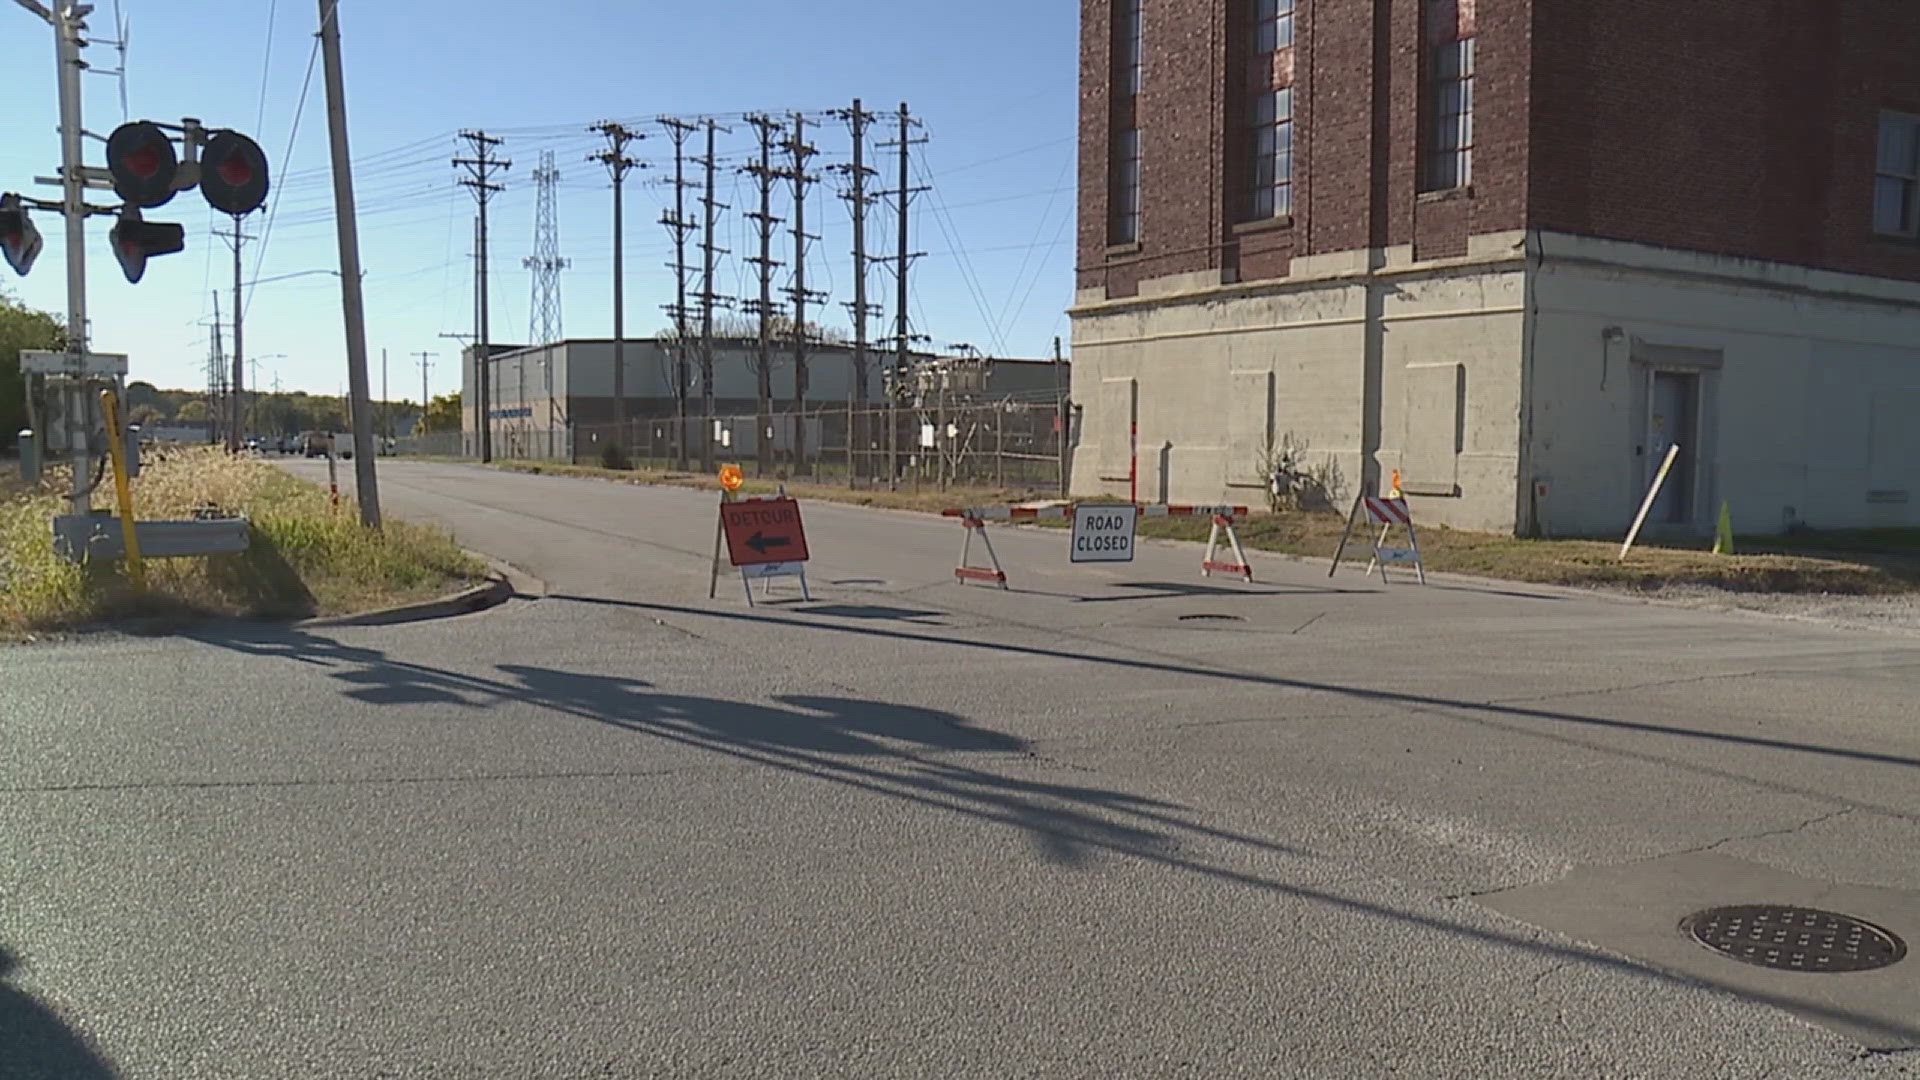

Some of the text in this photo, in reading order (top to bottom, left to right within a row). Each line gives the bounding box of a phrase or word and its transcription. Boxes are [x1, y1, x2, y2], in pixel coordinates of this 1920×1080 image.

[729, 509, 794, 527] DETOUR
[1086, 515, 1123, 530] ROAD
[1077, 535, 1128, 551] CLOSED
